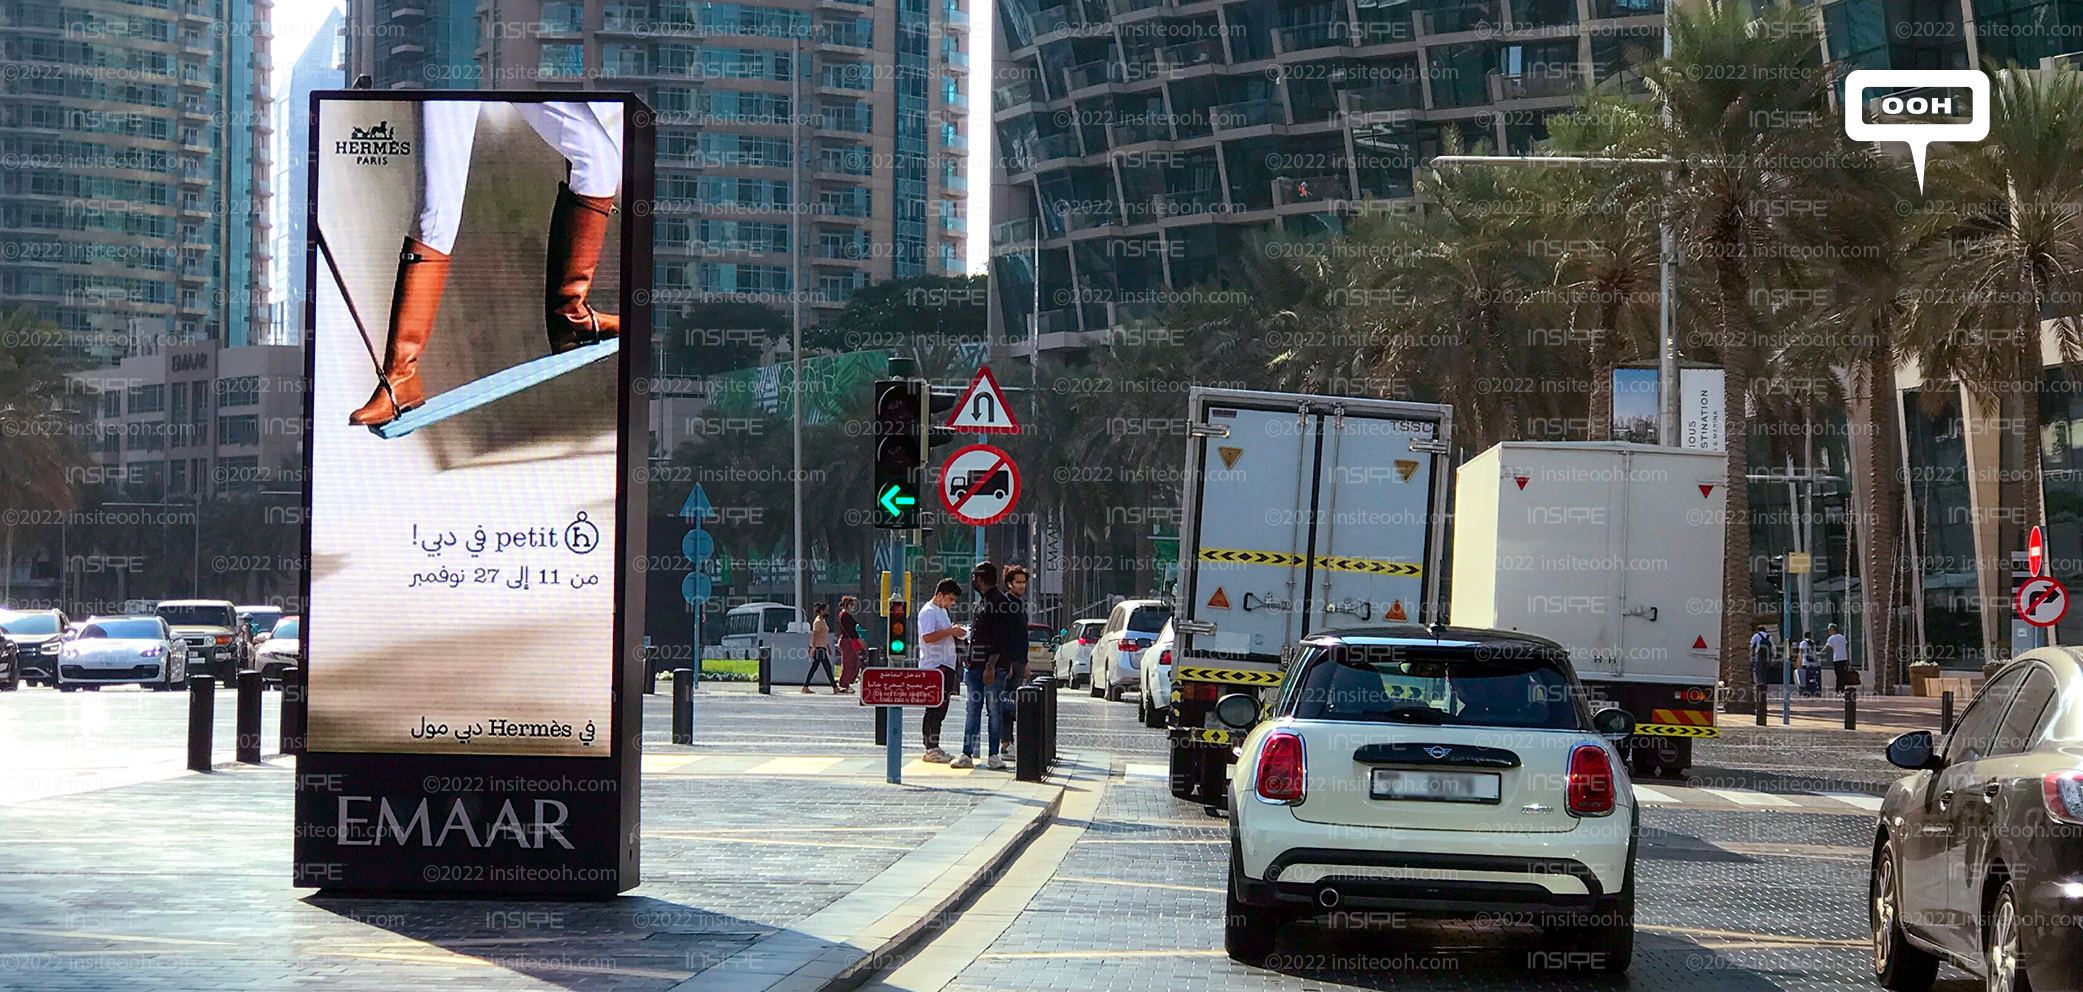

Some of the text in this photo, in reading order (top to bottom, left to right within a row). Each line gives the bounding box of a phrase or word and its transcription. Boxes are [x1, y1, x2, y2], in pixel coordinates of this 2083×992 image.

[356, 156, 388, 165] PARIS
[1390, 420, 1432, 433] TSSC
[1700, 390, 1709, 448] STINATION
[466, 525, 486, 558] في
[495, 527, 558, 553] petit
[409, 565, 598, 590] من 11 إلى 27 نوفمبر
[411, 716, 596, 746] في Hermès دبي مول
[337, 796, 575, 850] EMAAR
